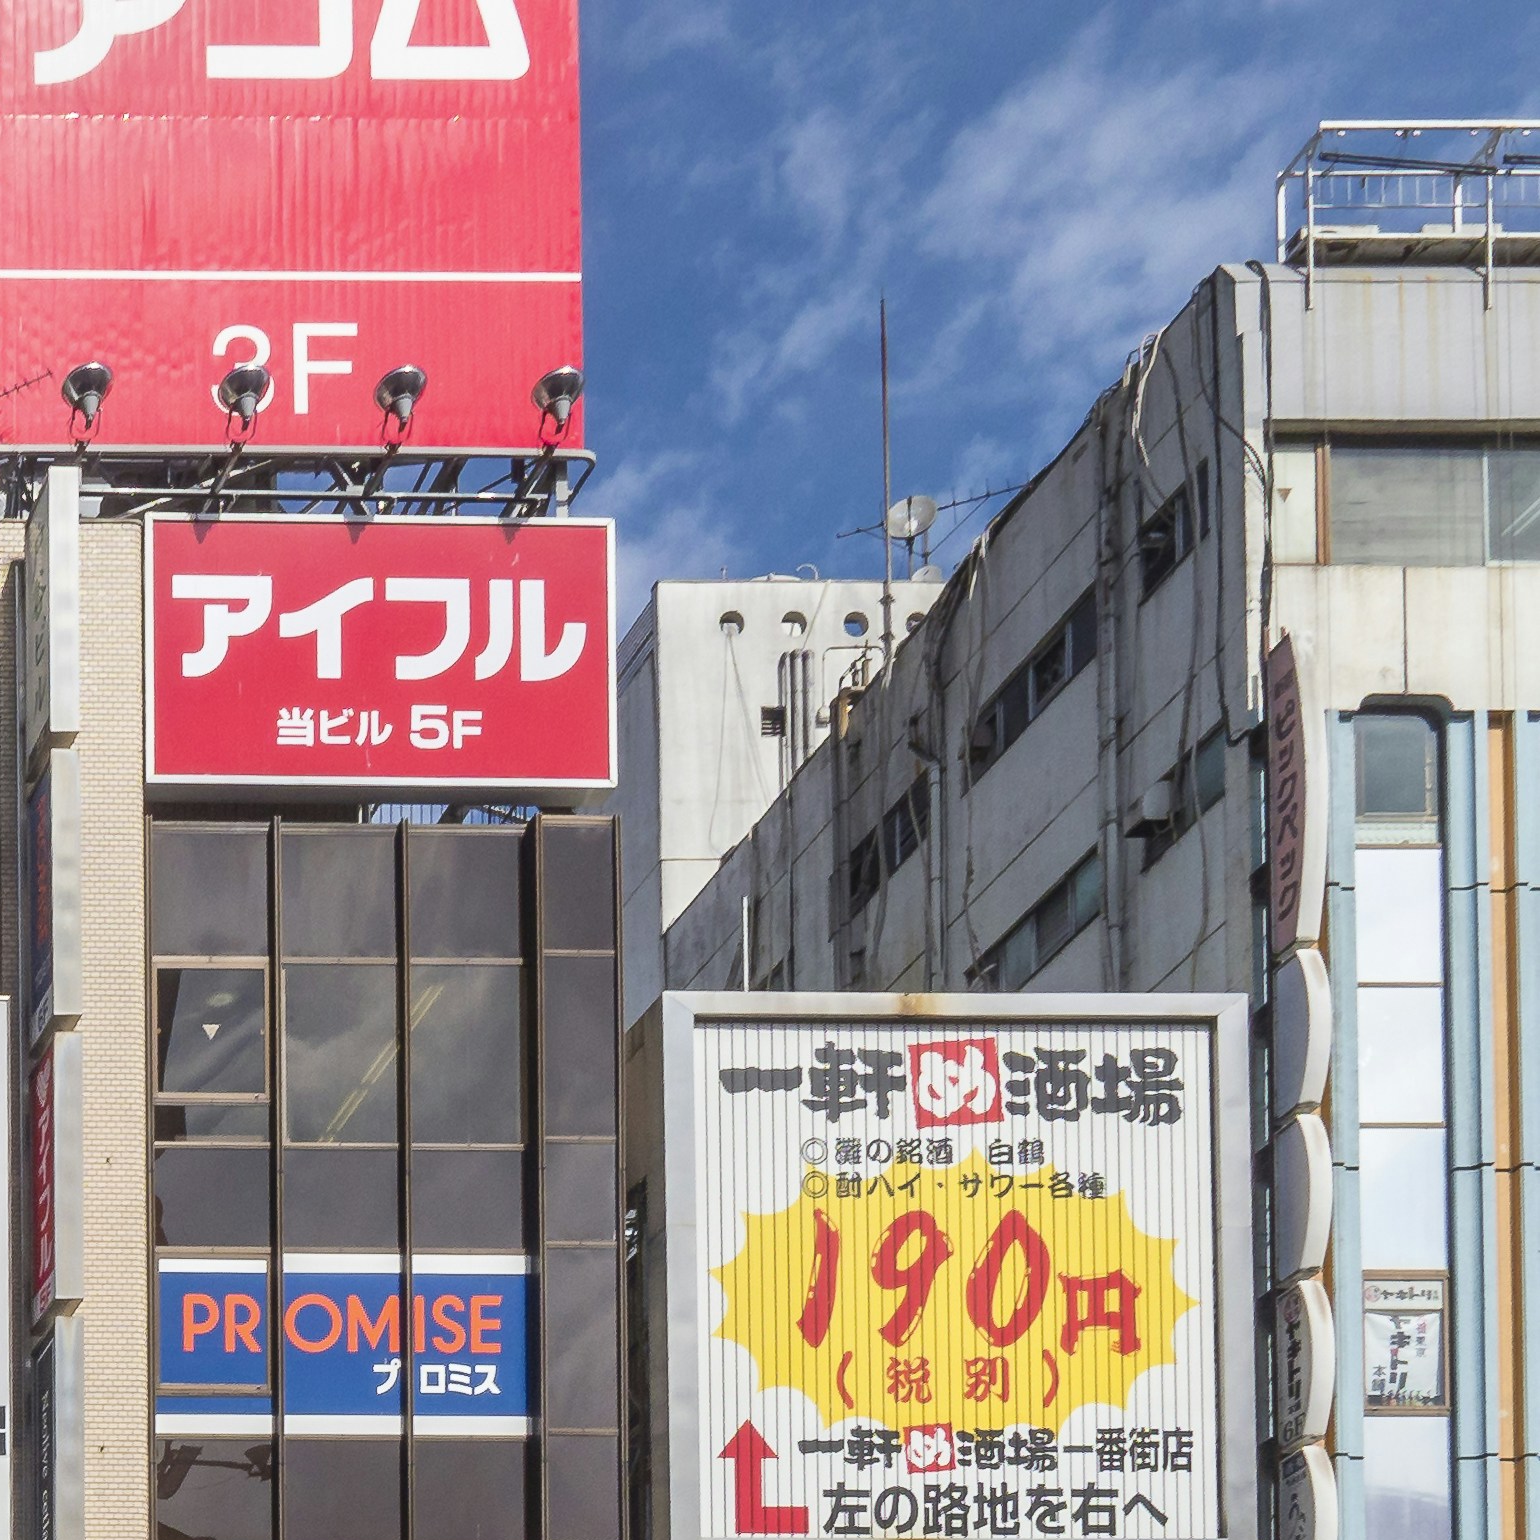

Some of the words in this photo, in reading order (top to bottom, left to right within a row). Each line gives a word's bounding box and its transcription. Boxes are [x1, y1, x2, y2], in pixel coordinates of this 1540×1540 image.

[171, 574, 589, 684] アイフル
[276, 707, 393, 749] 当ビル
[408, 704, 483, 751] 5F
[719, 1037, 1184, 1128] 一軒め酒場
[834, 1137, 954, 1167] 灘の銘酒
[988, 1137, 1046, 1167] 白鶴
[796, 1208, 1142, 1356] 190円
[182, 1293, 504, 1355] PROMISE
[373, 1358, 502, 1396] プロミス
[798, 1421, 1194, 1475] 一軒め酒場一番街店
[822, 1482, 1169, 1537] 左の路地を右へ
